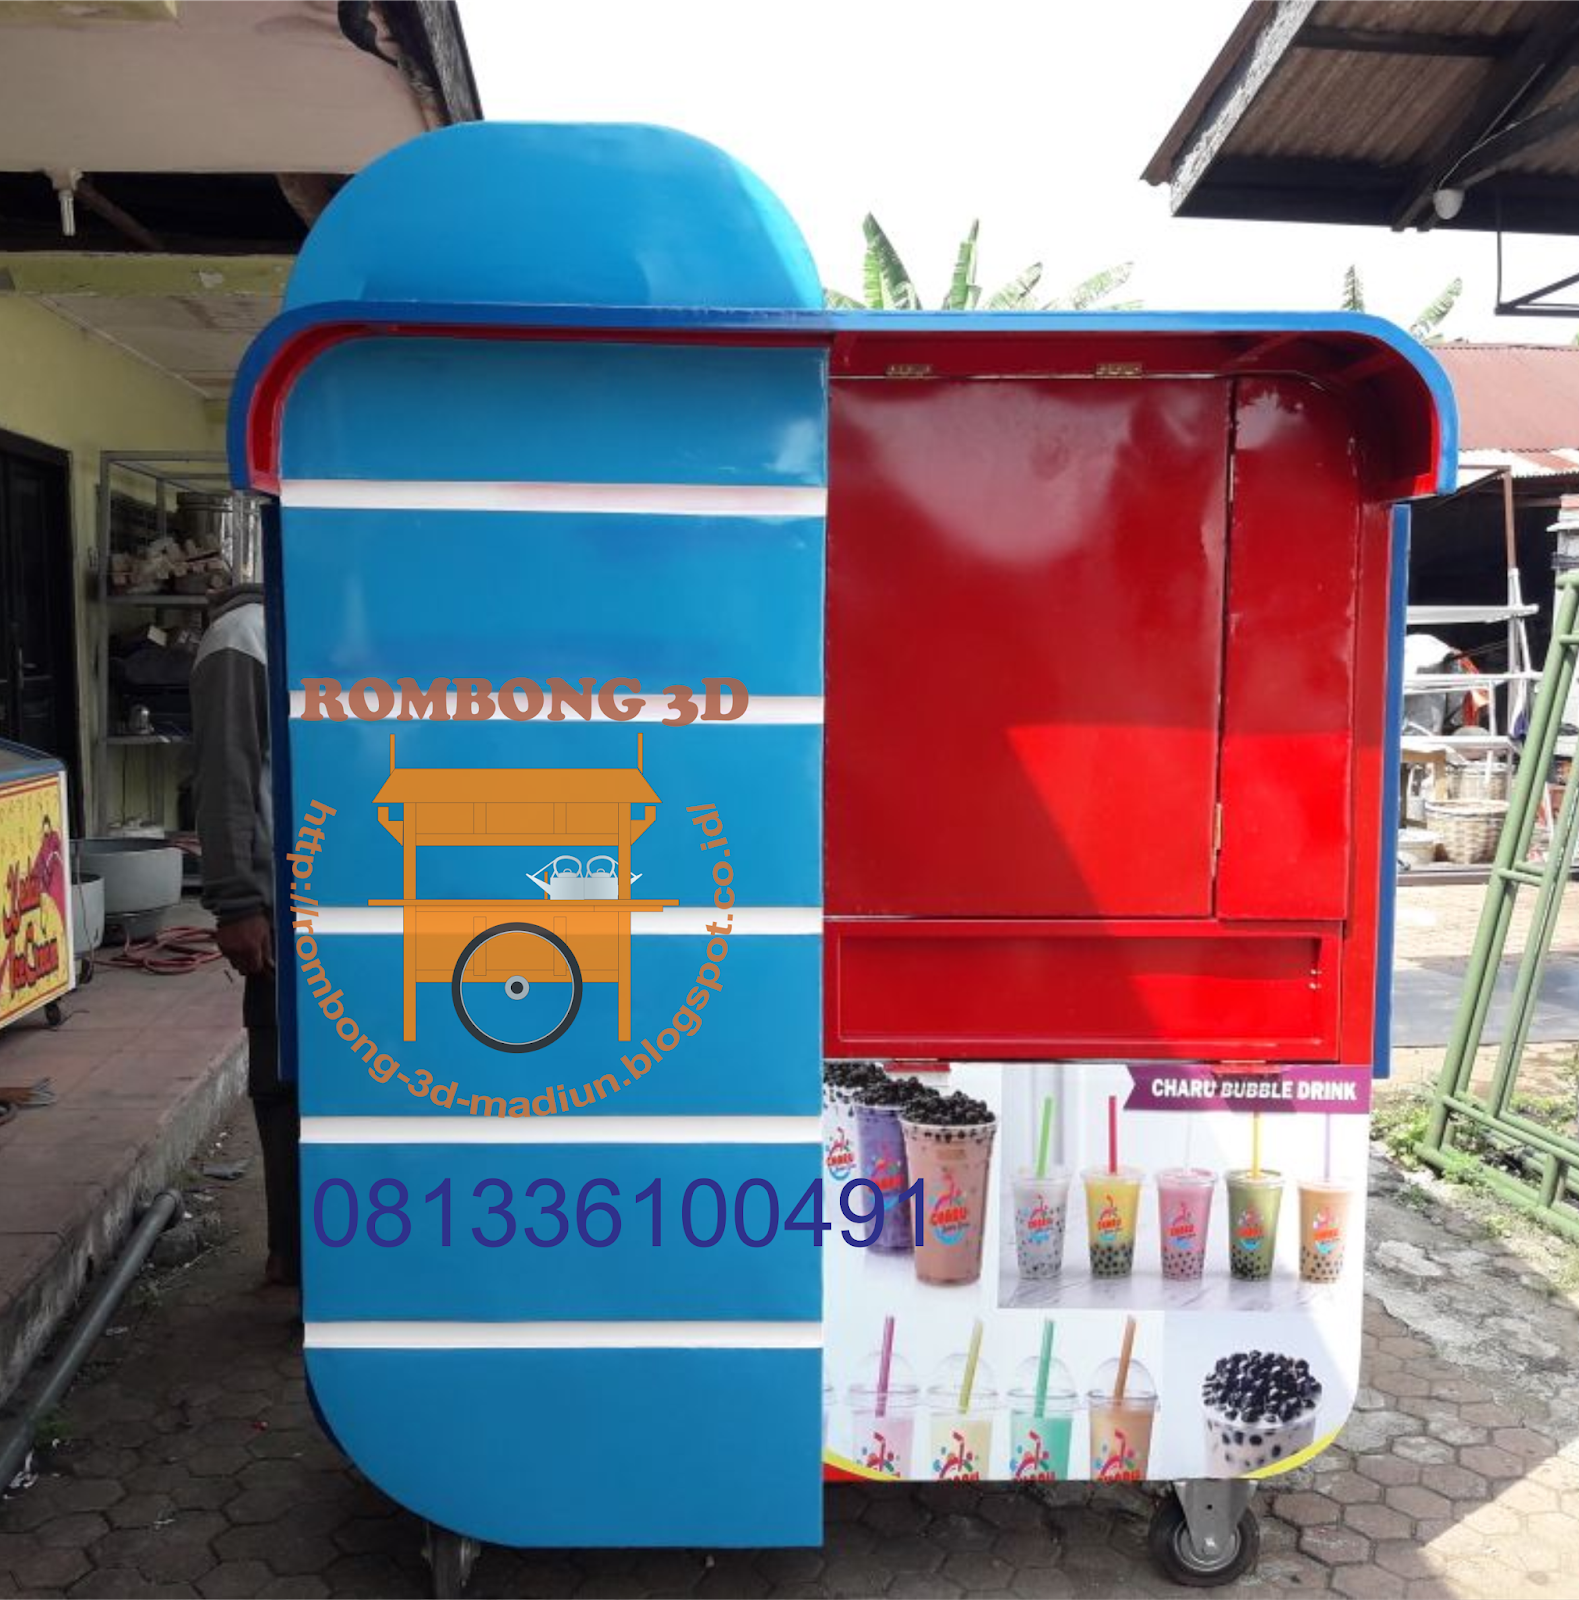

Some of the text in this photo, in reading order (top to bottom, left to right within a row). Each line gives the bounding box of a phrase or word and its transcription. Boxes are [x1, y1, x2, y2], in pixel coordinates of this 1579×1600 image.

[1151, 1078, 1357, 1100] CHARU BUBBLE DRINK
